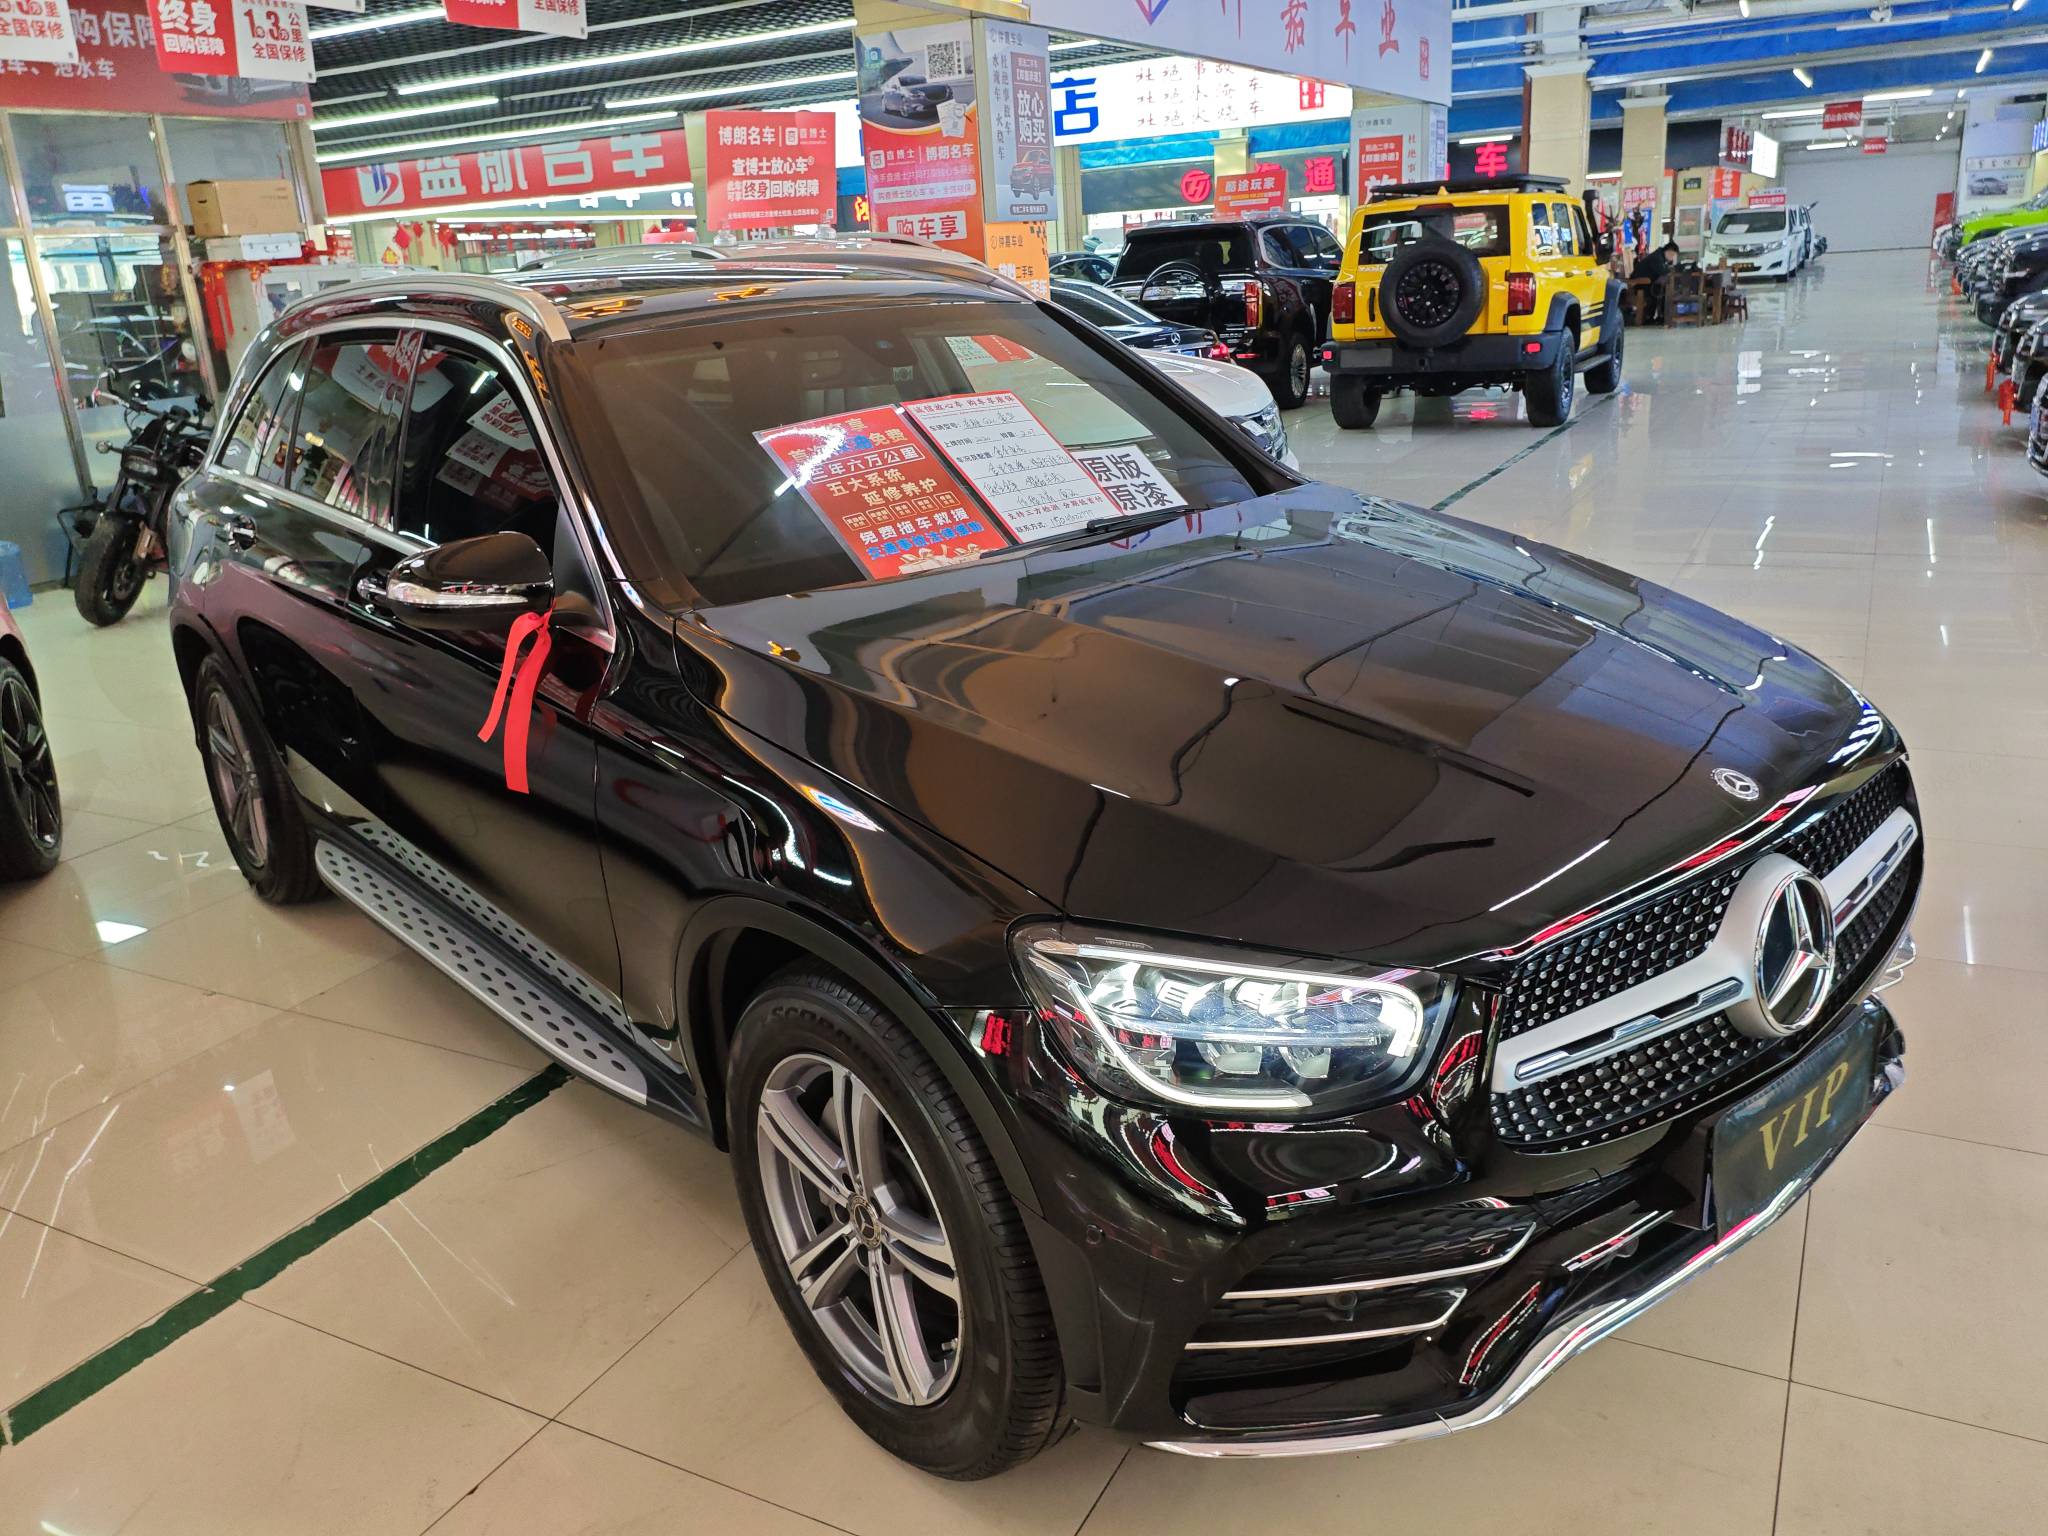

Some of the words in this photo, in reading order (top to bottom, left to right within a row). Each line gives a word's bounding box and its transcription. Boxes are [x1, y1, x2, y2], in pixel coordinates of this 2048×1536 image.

[158, 0, 217, 36] 终身
[162, 33, 226, 56] 回购保障
[252, 42, 307, 63] 全国保修
[1017, 89, 1044, 117] 放心
[1051, 77, 1099, 136] 店
[718, 125, 776, 146] 博朗名车
[1019, 117, 1046, 143] 购买
[1475, 142, 1508, 177] 车
[744, 179, 820, 199] 终身回购保障
[896, 214, 959, 240] 购车享
[811, 446, 920, 481] 三年六万公里
[1078, 453, 1151, 482] 原版
[826, 468, 906, 497] 五大系统
[862, 477, 938, 507] 延修养护
[1103, 480, 1174, 511] 原漆
[859, 507, 970, 545] 免费拖车救援
[866, 521, 985, 560] 交通事故法律援助
[1759, 1061, 1849, 1171] VIP
